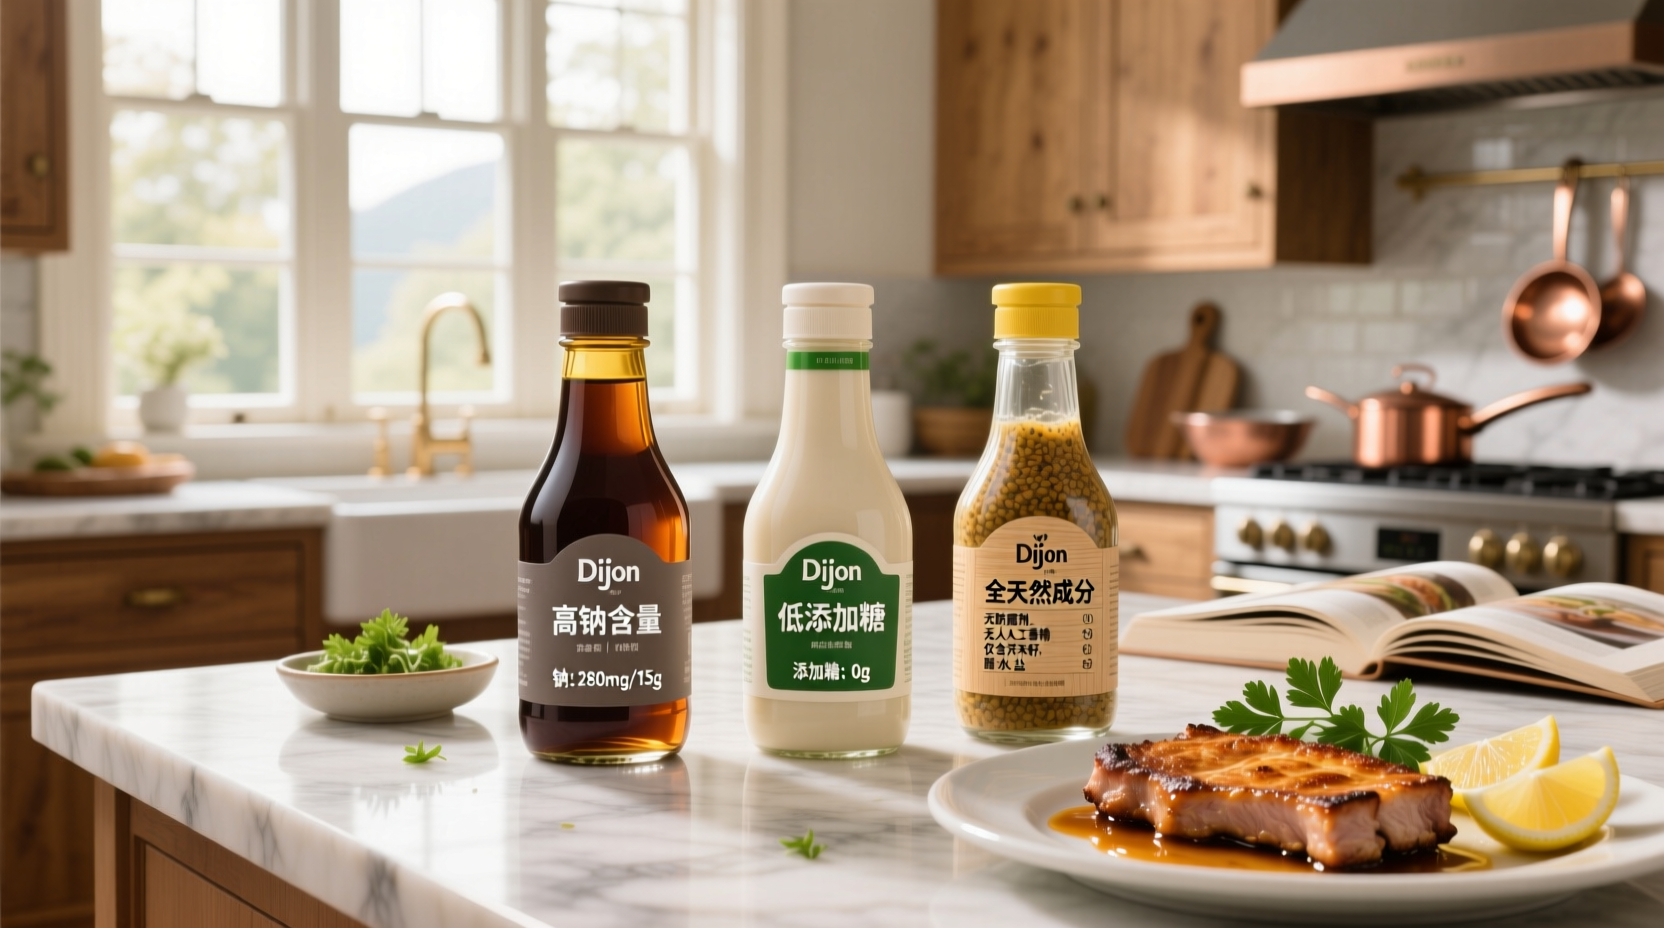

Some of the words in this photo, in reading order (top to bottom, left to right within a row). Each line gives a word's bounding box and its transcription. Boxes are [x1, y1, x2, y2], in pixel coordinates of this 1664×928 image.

[1016, 542, 1068, 570] Dijon
[577, 558, 640, 591] Dijon
[802, 558, 862, 591] Dijon
[985, 579, 1095, 605] 全天然成分
[552, 604, 662, 636] 高钠含量
[778, 601, 886, 633] 低添加糖
[851, 663, 871, 683] 0g
